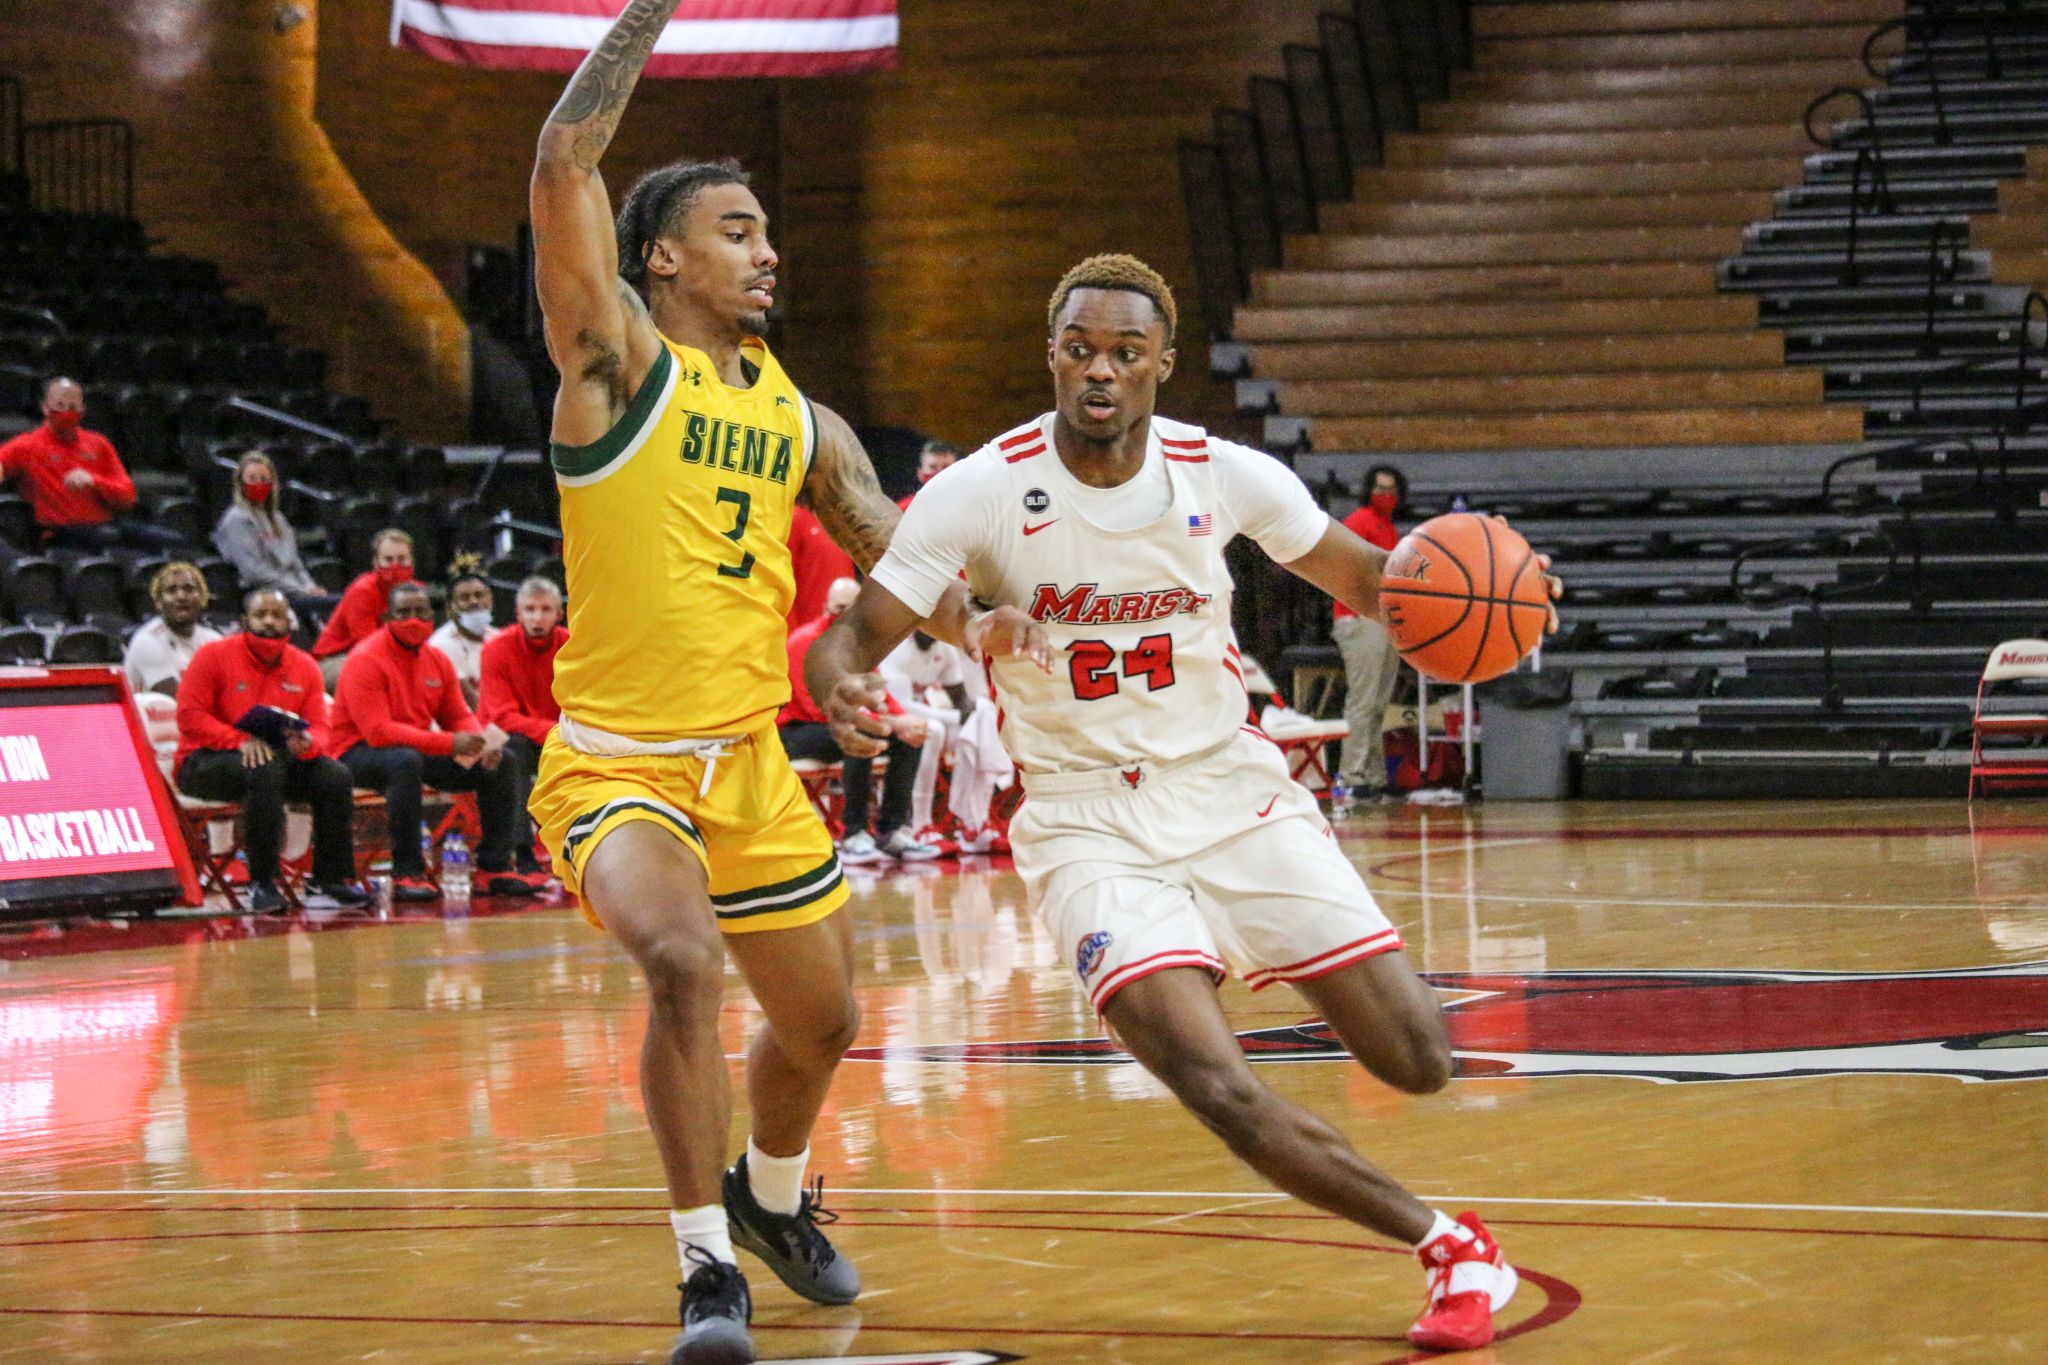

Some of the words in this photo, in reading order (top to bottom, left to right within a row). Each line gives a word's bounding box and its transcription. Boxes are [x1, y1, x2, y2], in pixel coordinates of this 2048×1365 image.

[680, 409, 793, 485] SIENA
[1026, 496, 1047, 506] BLM
[715, 486, 756, 579] 3
[1028, 583, 1212, 625] MARIST
[1064, 633, 1175, 700] 24
[0, 807, 155, 862] BASKETBALL
